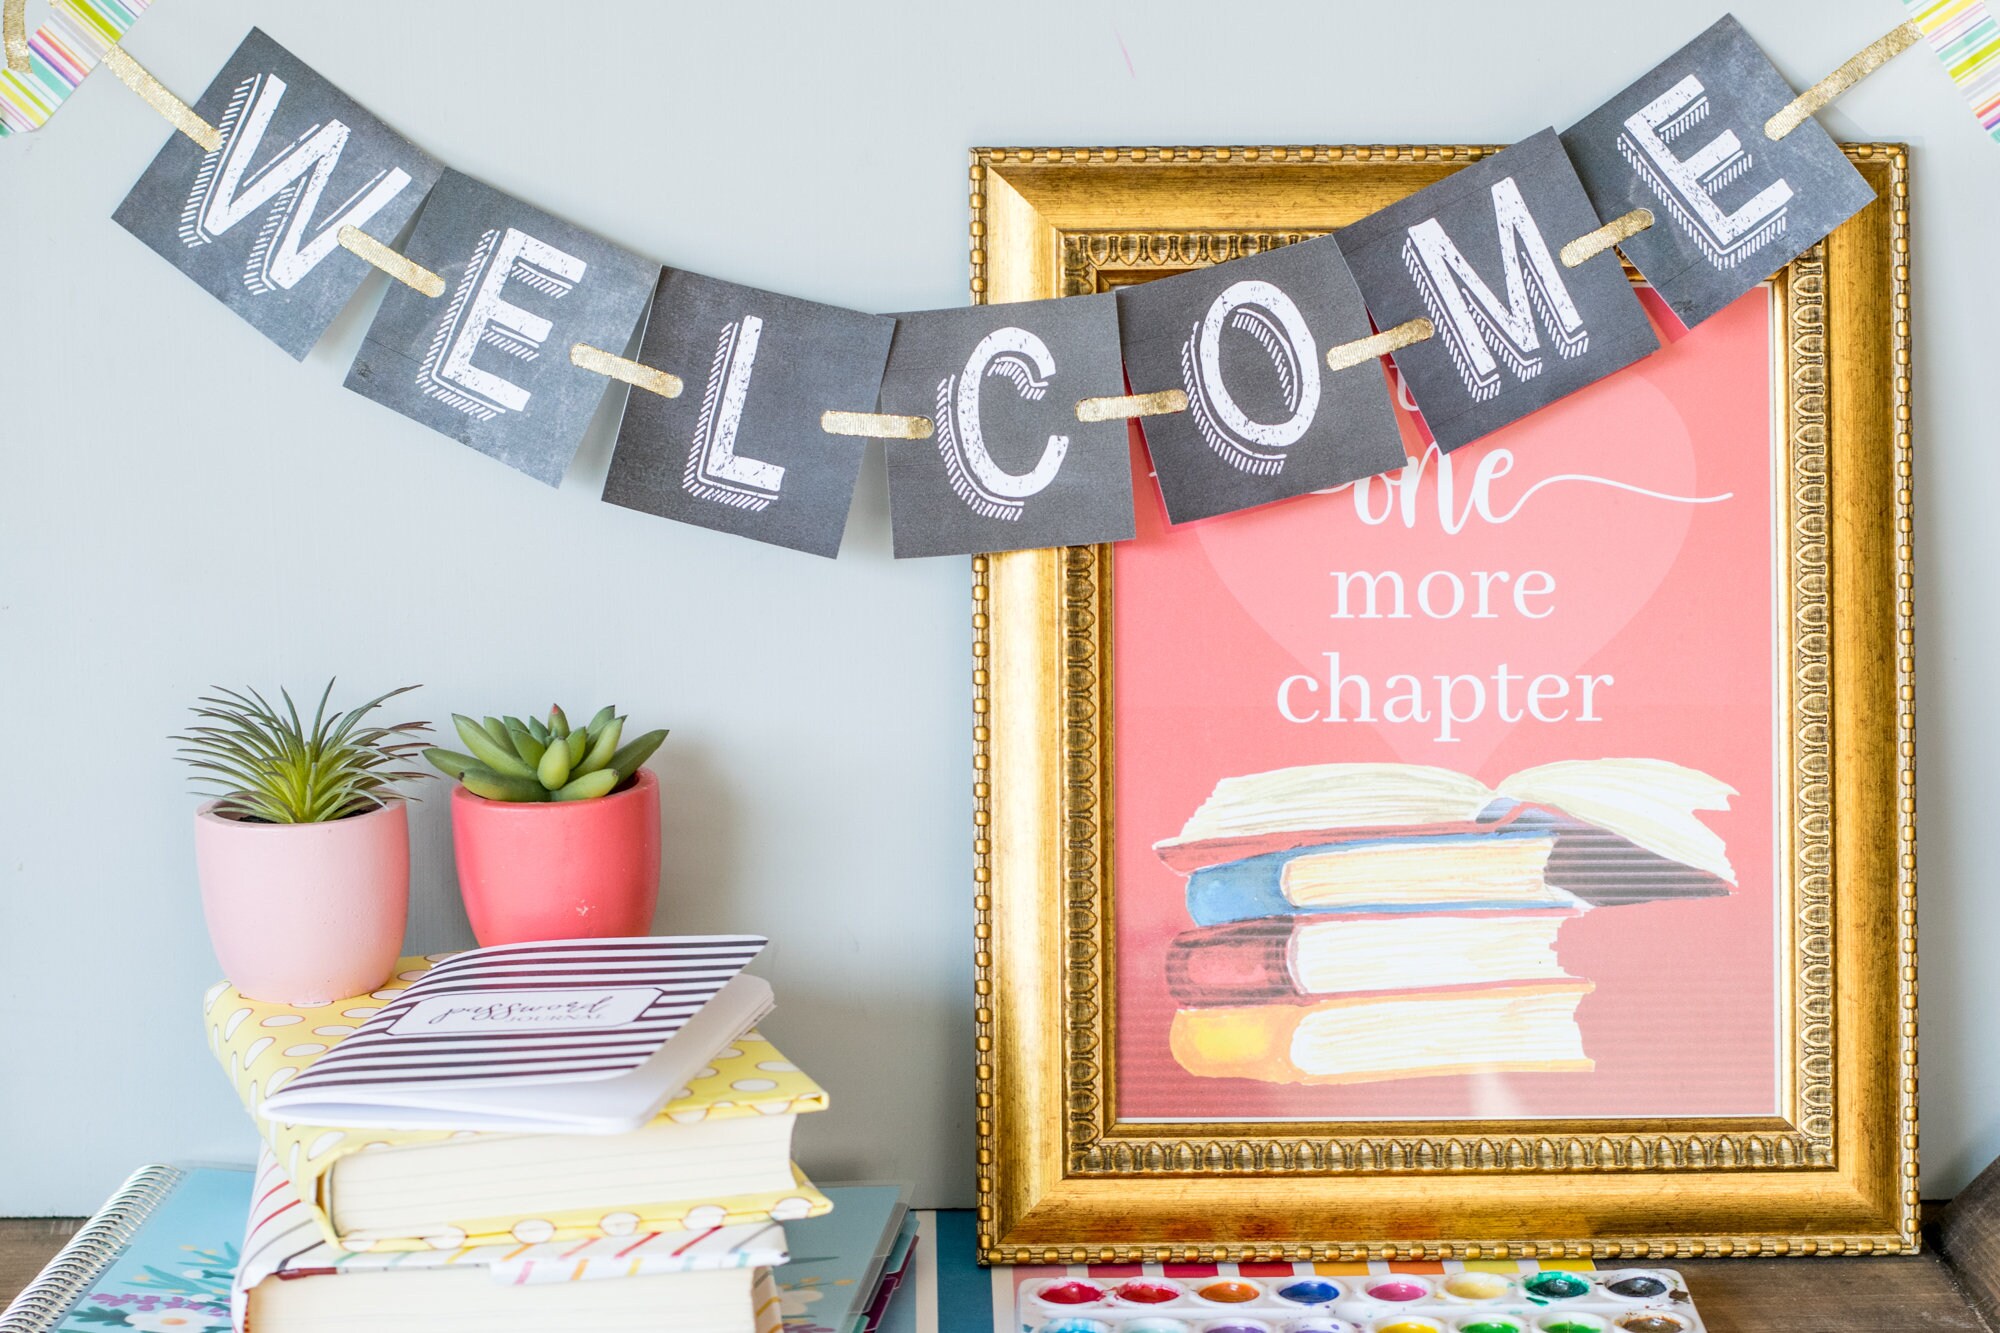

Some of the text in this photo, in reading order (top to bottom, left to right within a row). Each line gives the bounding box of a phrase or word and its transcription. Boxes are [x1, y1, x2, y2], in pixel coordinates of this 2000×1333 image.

[178, 72, 1795, 523] WELCOME
[1329, 569, 1557, 620] more
[1277, 651, 1615, 743] chapter
[428, 995, 614, 1025] password
[504, 1013, 607, 1023] JOURNAL
